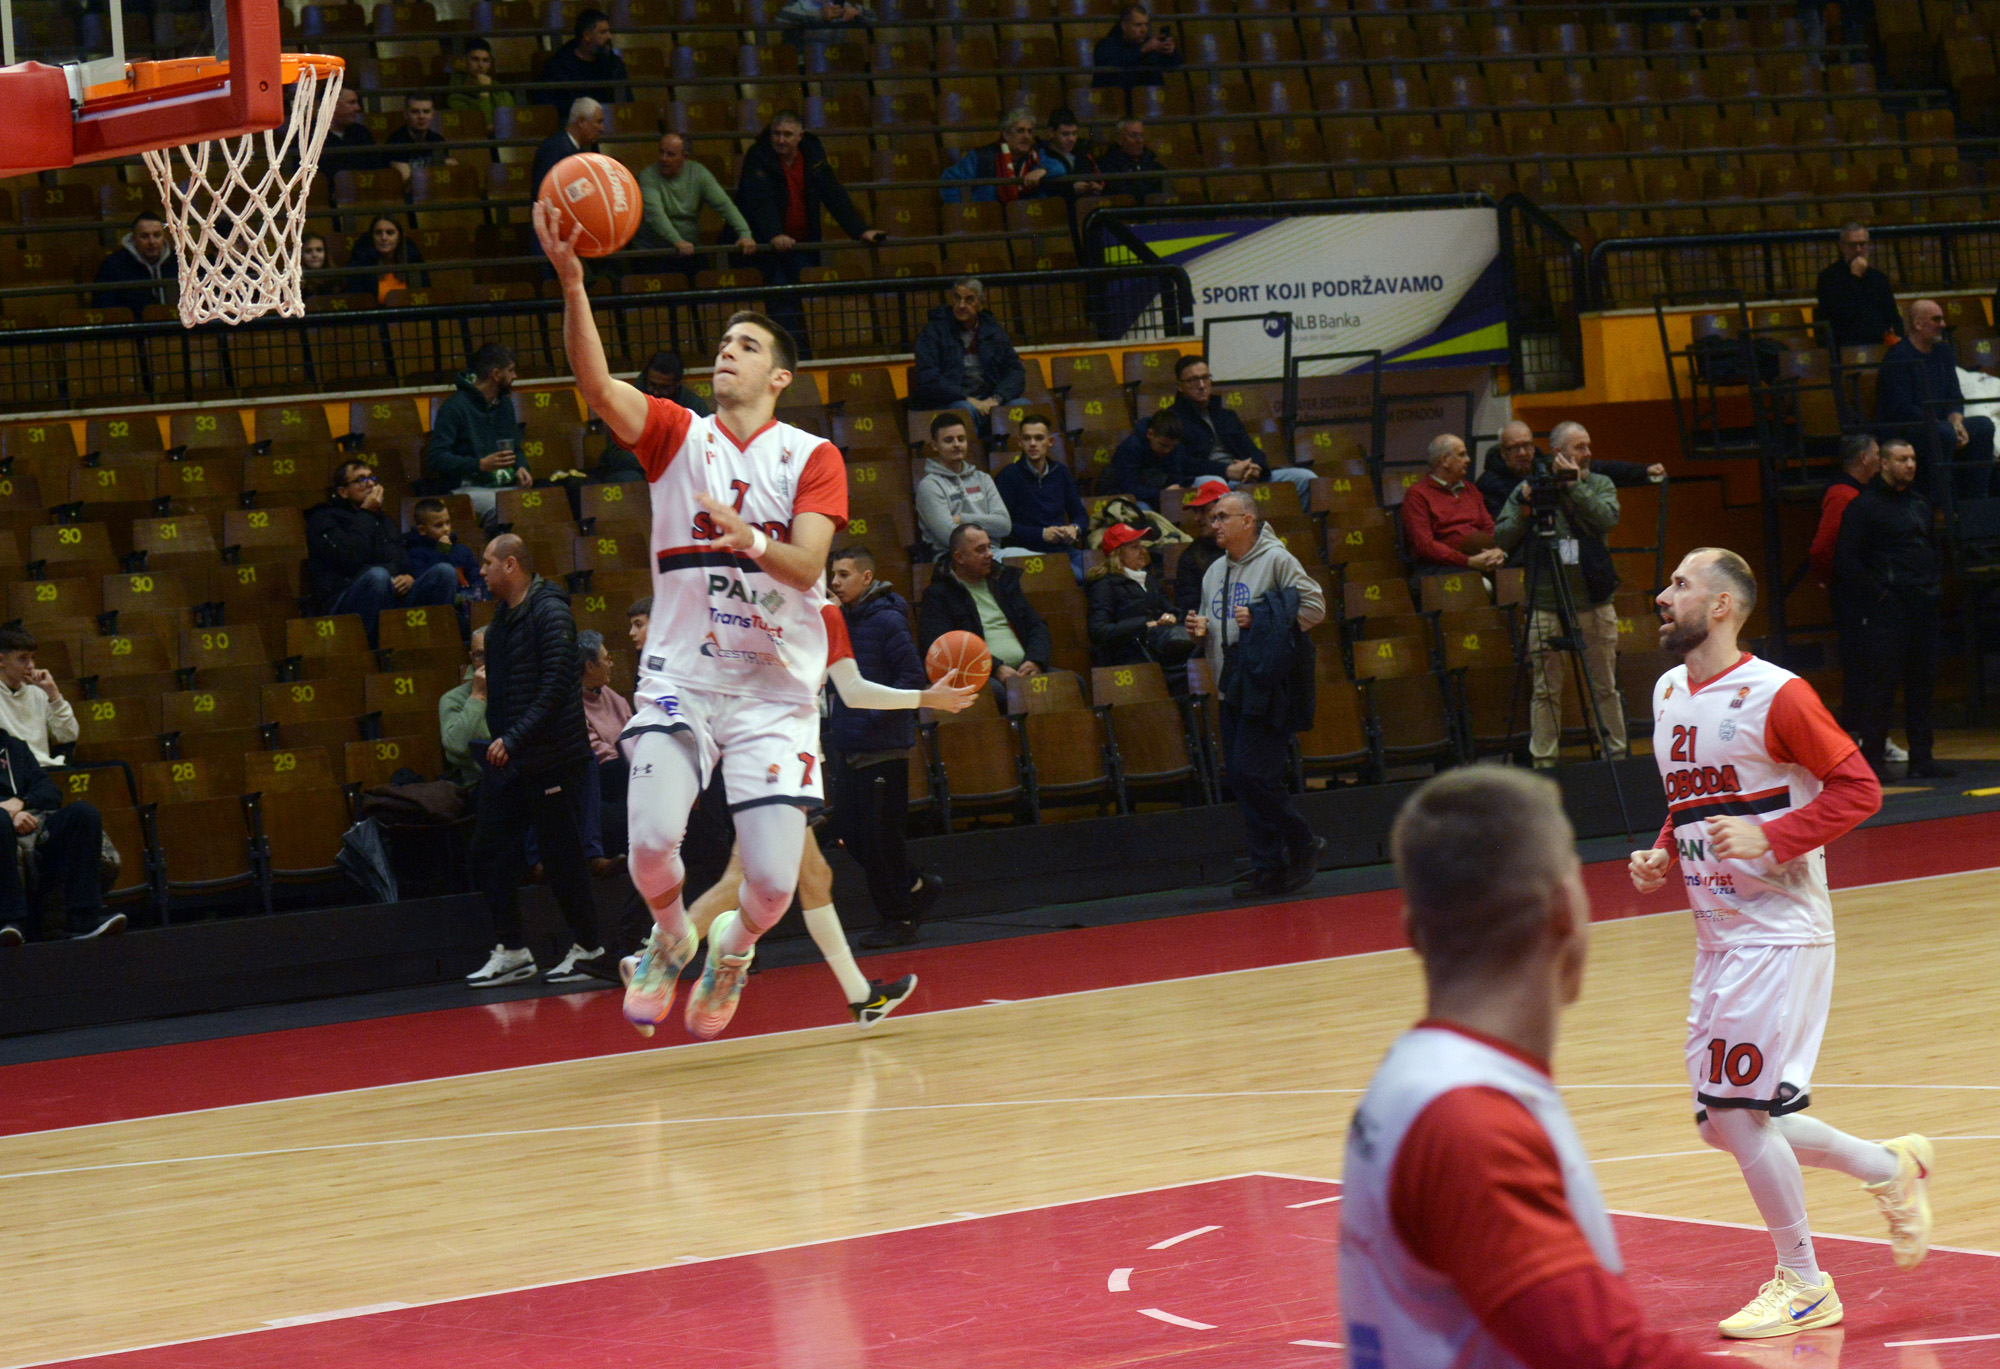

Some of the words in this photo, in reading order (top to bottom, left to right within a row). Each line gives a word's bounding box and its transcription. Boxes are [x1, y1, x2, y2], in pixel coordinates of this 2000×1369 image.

[359, 173, 375, 187] 37
[962, 208, 978, 219] 44
[423, 233, 440, 248] 37
[24, 254, 42, 268] 32
[645, 278, 662, 292] 39
[719, 273, 736, 287] 44
[1203, 285, 1259, 304] SPORT
[1266, 282, 1306, 301] KOJI
[1312, 275, 1443, 299] PODRŽAVAMO
[1290, 315, 1316, 331] NLB
[1319, 312, 1360, 330] Banka
[1074, 358, 1090, 371] 44
[1143, 354, 1159, 367] 45
[849, 374, 863, 387] 41
[534, 393, 551, 408] 37
[1227, 392, 1243, 405] 45
[372, 405, 391, 419] 35
[1009, 408, 1024, 421] 42
[1085, 402, 1103, 415] 43
[196, 416, 217, 431] 33
[282, 410, 302, 426] 34
[854, 418, 873, 431] 40
[28, 428, 46, 443] 31
[109, 422, 129, 437] 32
[1313, 433, 1331, 447] 45
[524, 442, 544, 456] 36
[1094, 450, 1109, 464] 42
[182, 467, 204, 482] 32
[273, 459, 295, 475] 33
[98, 470, 117, 486] 31
[855, 468, 877, 483] 39
[0, 480, 13, 496] 0
[603, 486, 623, 501] 36
[1333, 479, 1351, 493] 44
[522, 493, 541, 508] 35
[1254, 488, 1270, 500] 43
[247, 512, 269, 528] 32
[849, 519, 867, 534] 38
[58, 528, 82, 544] 30
[160, 524, 178, 540] 31
[1345, 531, 1363, 546] 43
[598, 540, 617, 555] 35
[1025, 558, 1043, 573] 39
[237, 567, 256, 584] 31
[130, 576, 154, 592] 30
[1444, 577, 1462, 592] 43
[35, 585, 58, 602] 29
[1364, 585, 1381, 600] 42
[585, 596, 606, 612] 34
[406, 610, 427, 626] 32
[317, 621, 335, 637] 31
[110, 639, 133, 656] 29
[1463, 635, 1480, 650] 42
[1377, 644, 1393, 658] 41
[1031, 676, 1048, 692] 37
[1114, 669, 1133, 686] 38
[395, 678, 413, 694] 31
[291, 686, 315, 702] 30
[193, 695, 216, 712] 29
[91, 702, 116, 721] 28
[377, 744, 399, 760] 30
[1671, 725, 1698, 764] 21
[273, 753, 296, 772] 29
[797, 752, 815, 788] 7
[172, 763, 196, 781] 28
[69, 774, 91, 793] 27
[1665, 765, 1741, 801] OBODA
[1678, 838, 1705, 861] AN
[1707, 1038, 1763, 1086] 10
